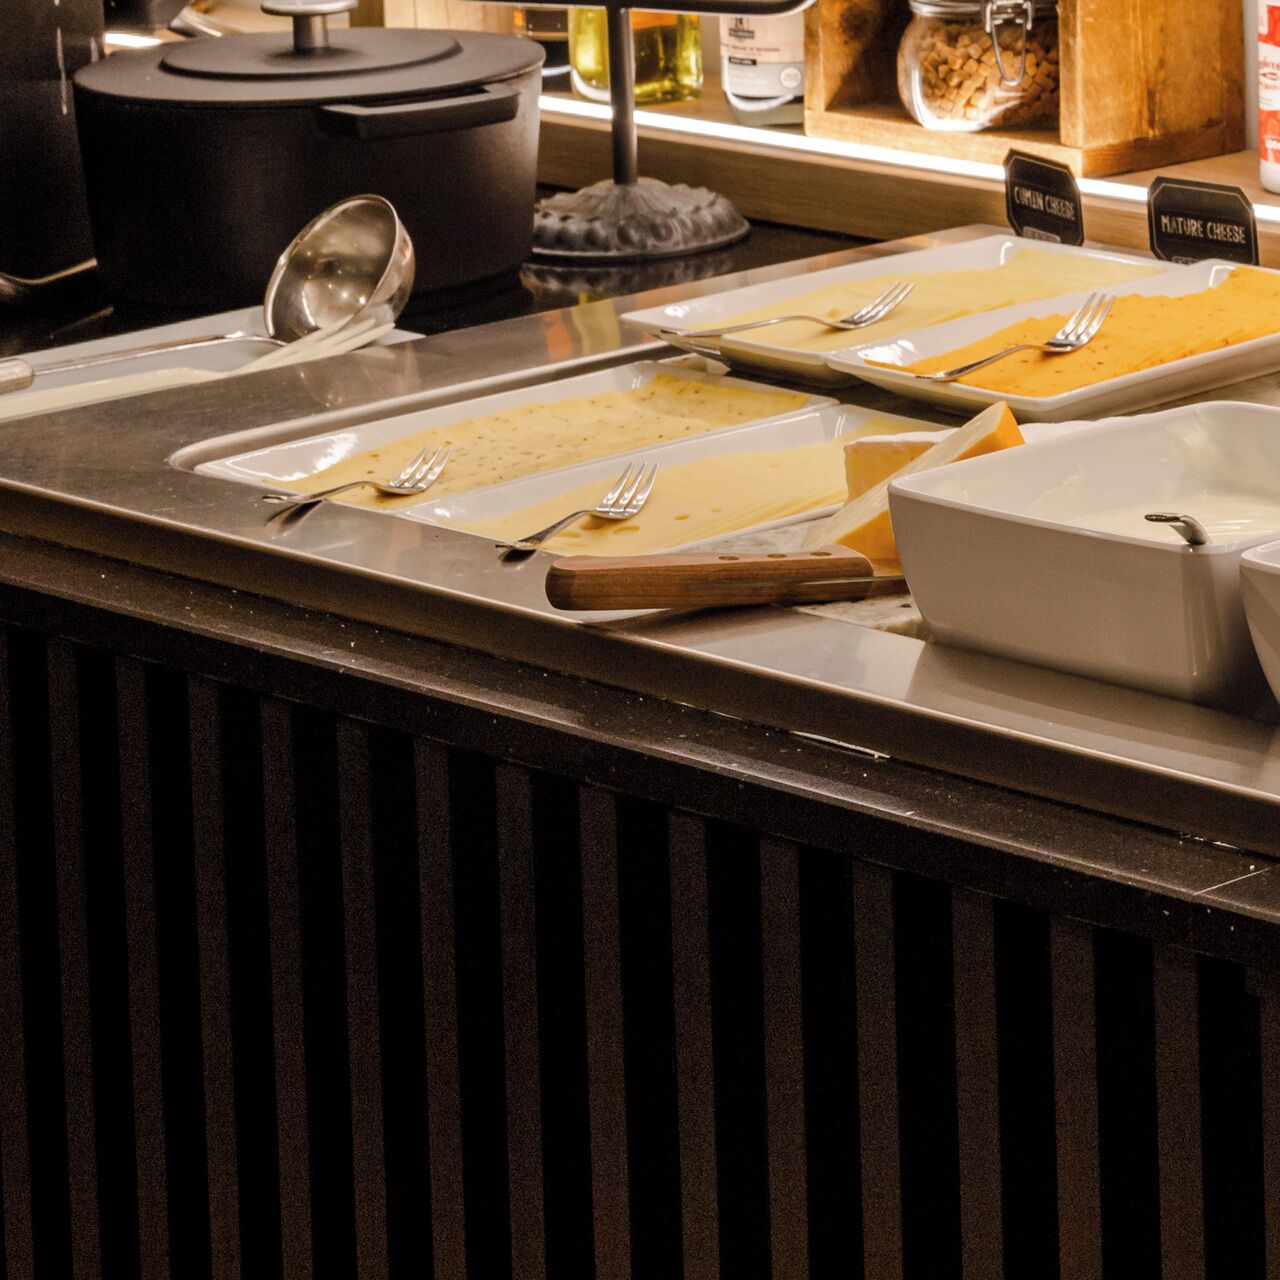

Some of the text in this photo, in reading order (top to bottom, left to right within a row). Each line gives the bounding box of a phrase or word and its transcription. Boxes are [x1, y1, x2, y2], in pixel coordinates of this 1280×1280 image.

[1014, 186, 1076, 221] CUMIN CHEESE
[1161, 215, 1246, 244] MATURE CHEESE
